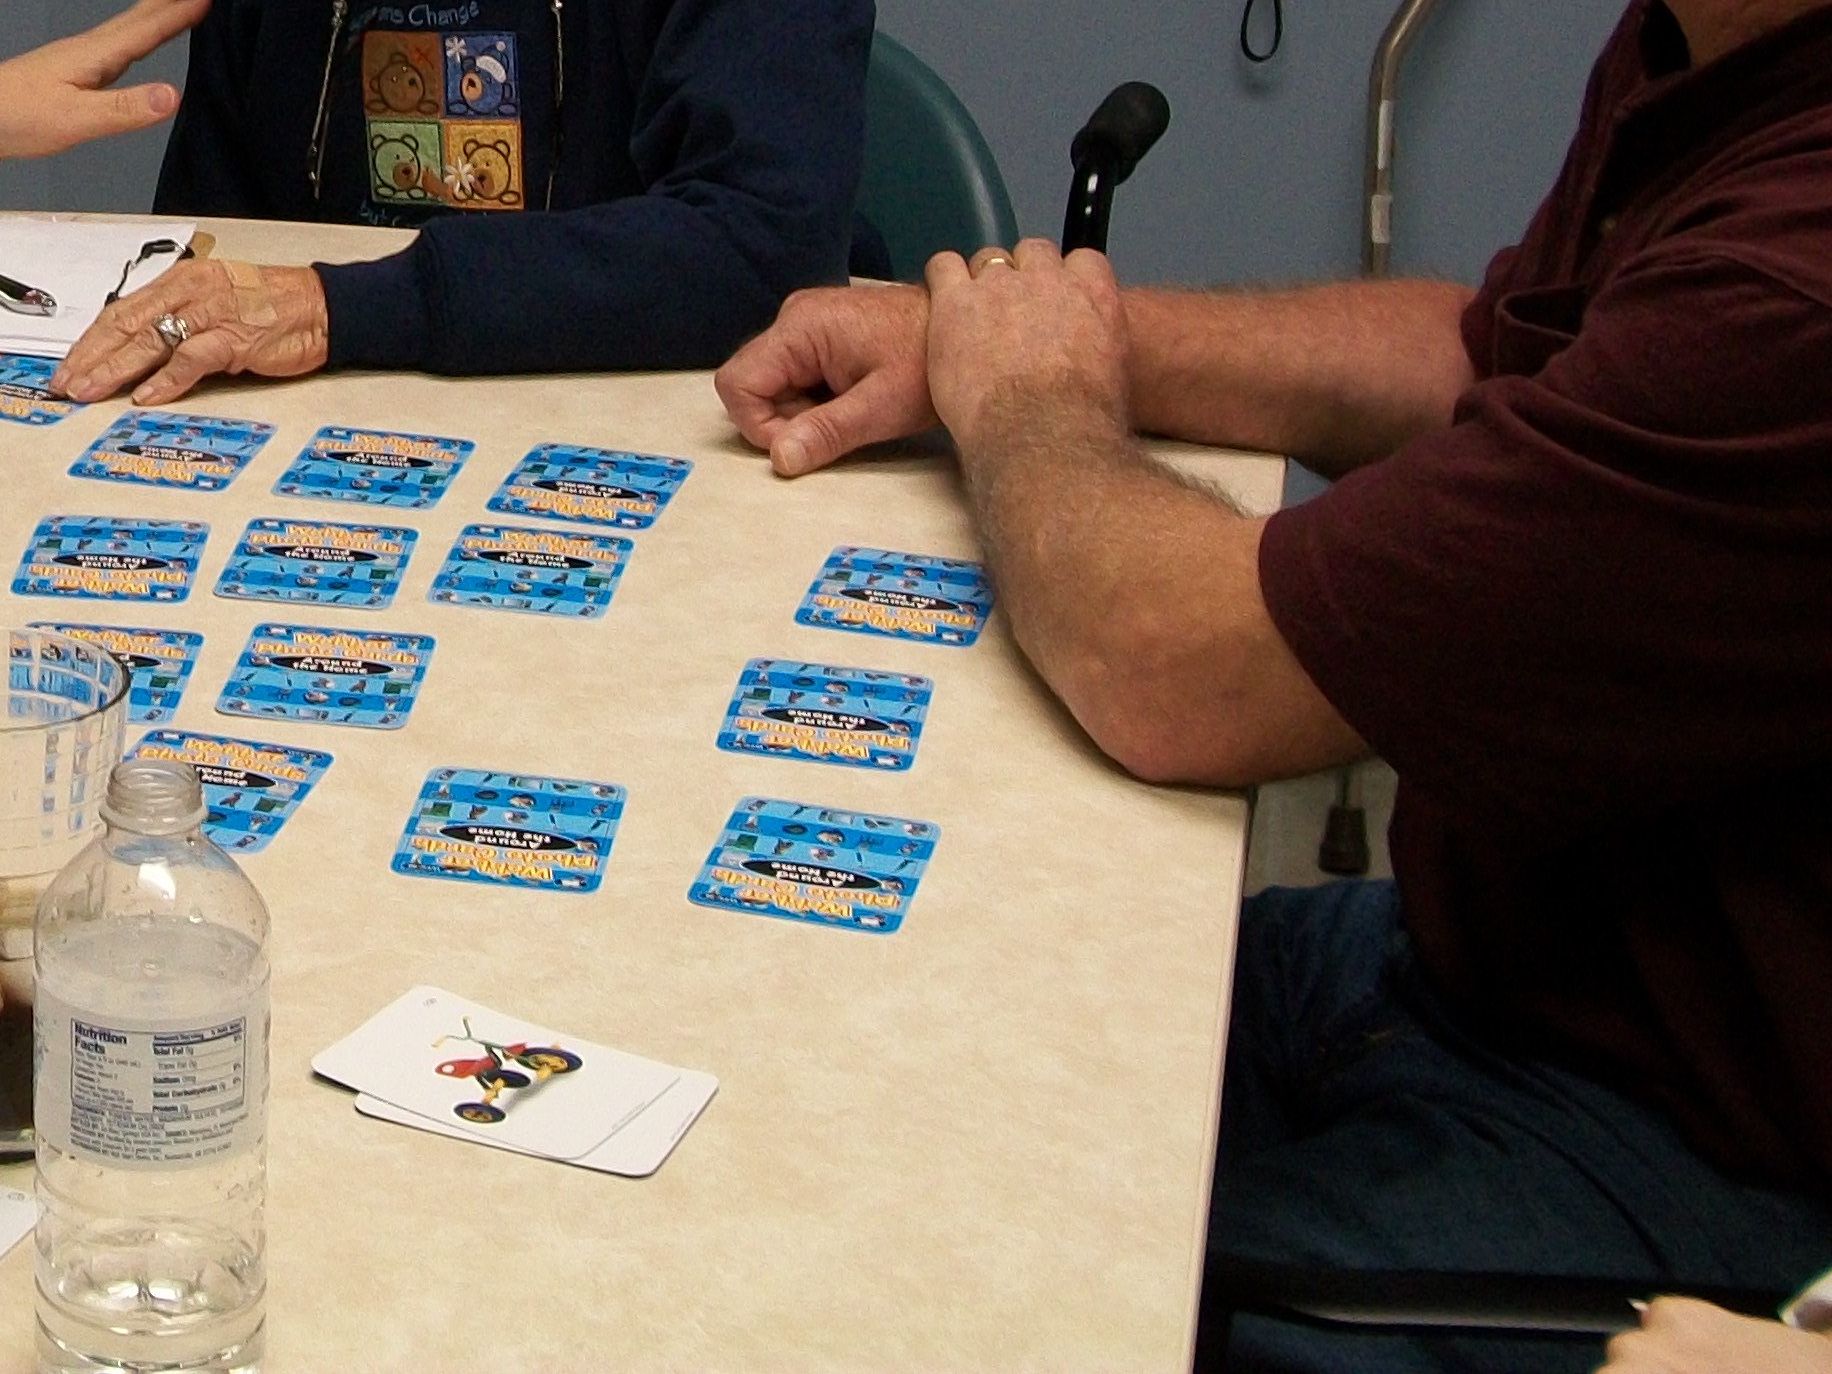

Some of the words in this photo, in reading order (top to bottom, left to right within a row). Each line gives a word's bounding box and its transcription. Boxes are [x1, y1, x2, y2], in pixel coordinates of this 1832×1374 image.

[408, 0, 480, 26] Change
[75, 1021, 127, 1045] Nutrition
[75, 1034, 106, 1054] Facts
